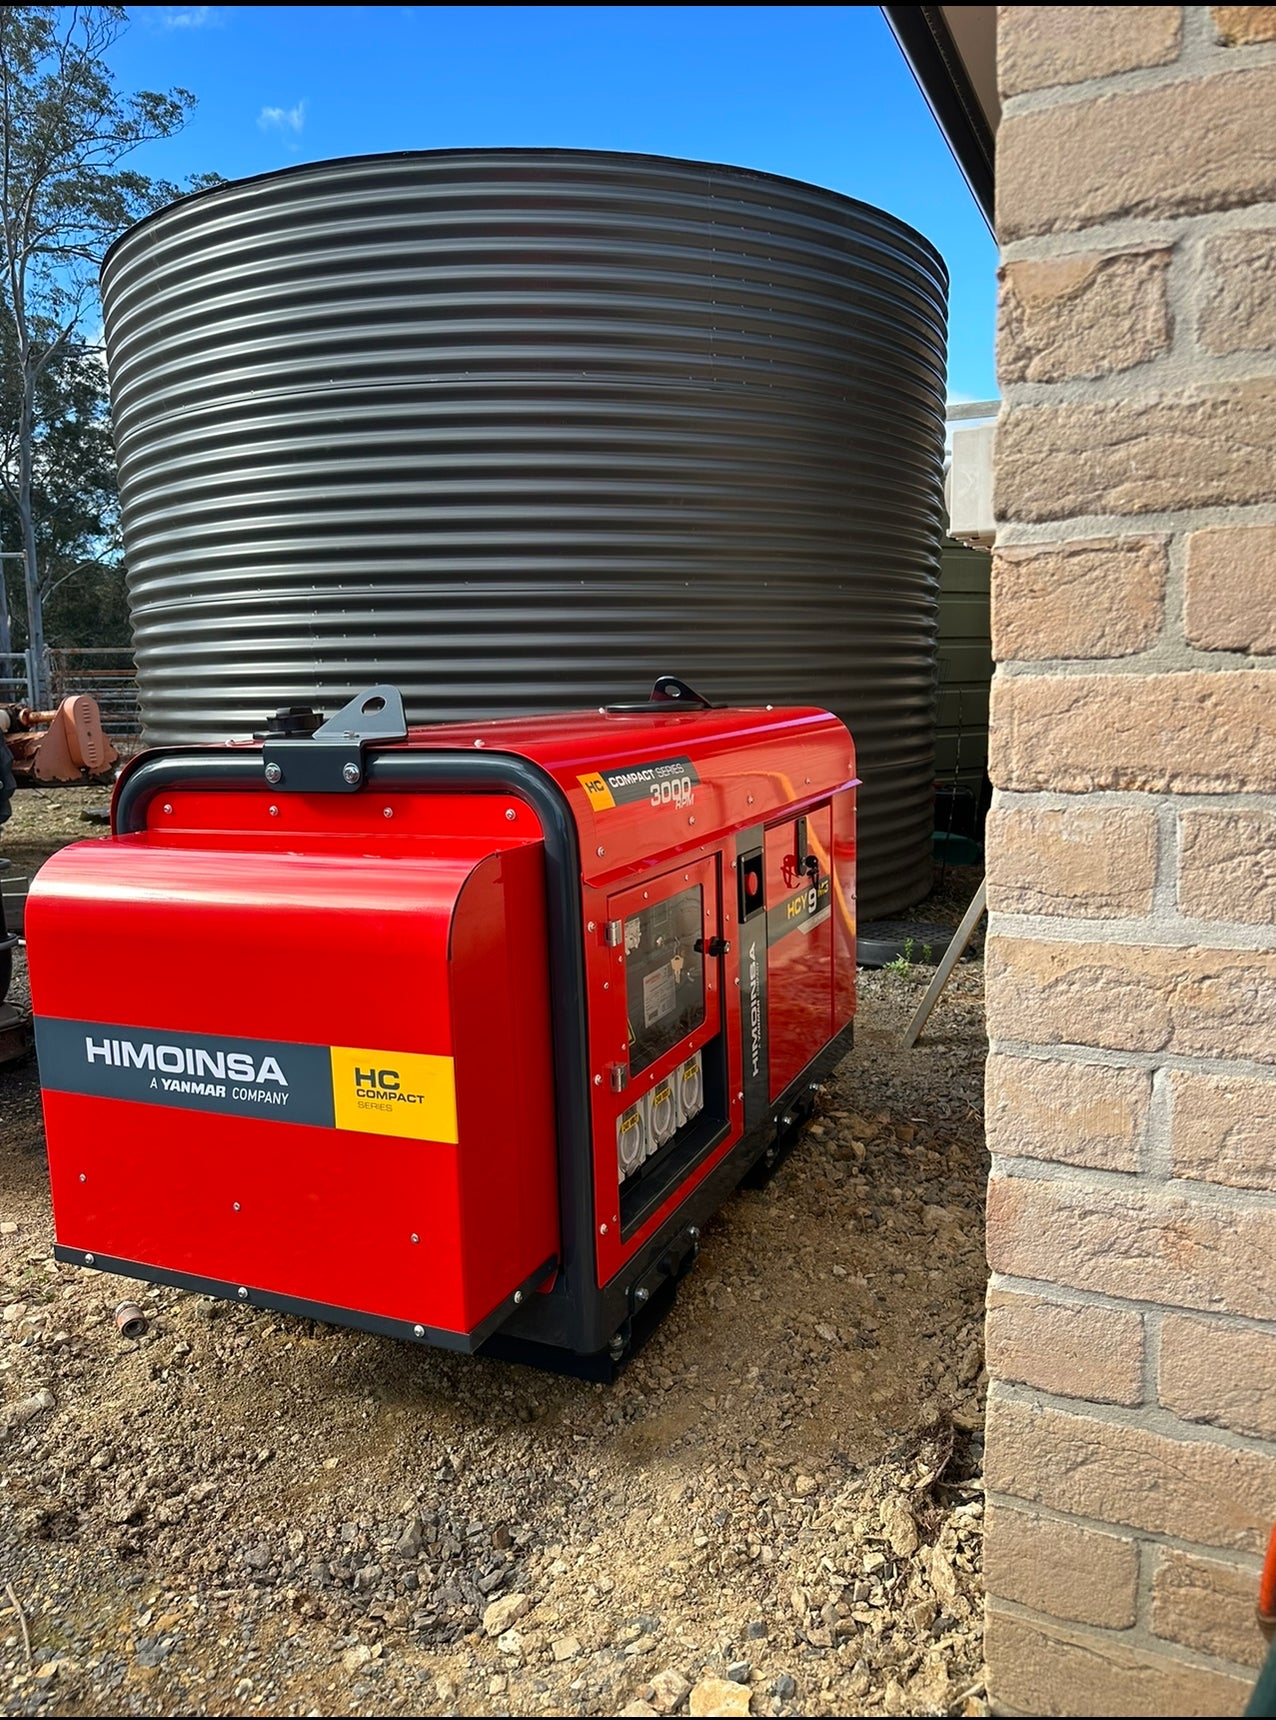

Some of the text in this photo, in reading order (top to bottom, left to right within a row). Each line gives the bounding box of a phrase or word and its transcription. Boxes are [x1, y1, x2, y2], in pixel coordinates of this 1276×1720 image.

[585, 763, 685, 794] HC COMPACT SERIES
[650, 776, 692, 807] 3000
[675, 793, 695, 810] RPM
[749, 941, 759, 1078] HIMOINSA
[85, 1036, 289, 1086] HIMOINSA
[150, 1077, 289, 1105] A YANMAR COMPANY
[354, 1067, 400, 1090] HC
[356, 1088, 425, 1104] COMPACT
[357, 1101, 393, 1112] SERIES
